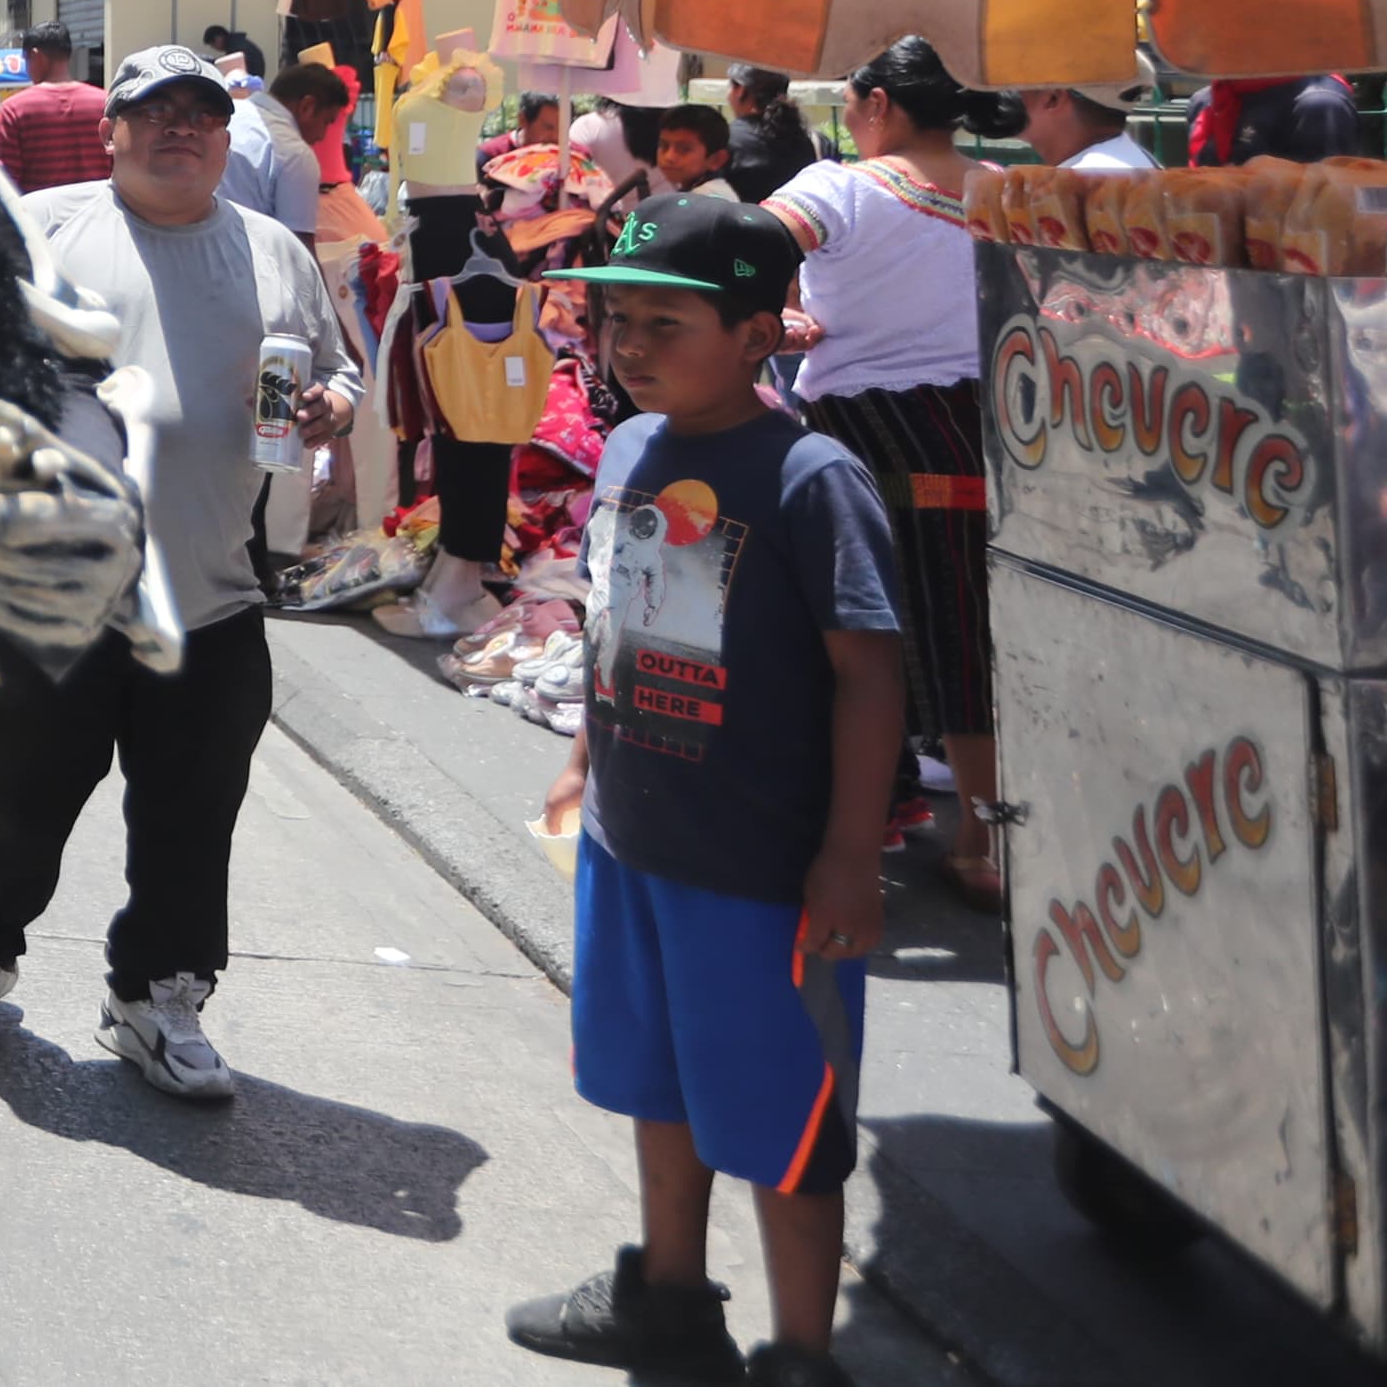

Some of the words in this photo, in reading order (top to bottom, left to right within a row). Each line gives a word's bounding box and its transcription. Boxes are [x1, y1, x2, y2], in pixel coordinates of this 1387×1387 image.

[992, 325, 1305, 530] Chevere
[638, 689, 701, 717] HERE
[640, 653, 719, 685] OUTTA
[1033, 735, 1272, 1077] Chevere
